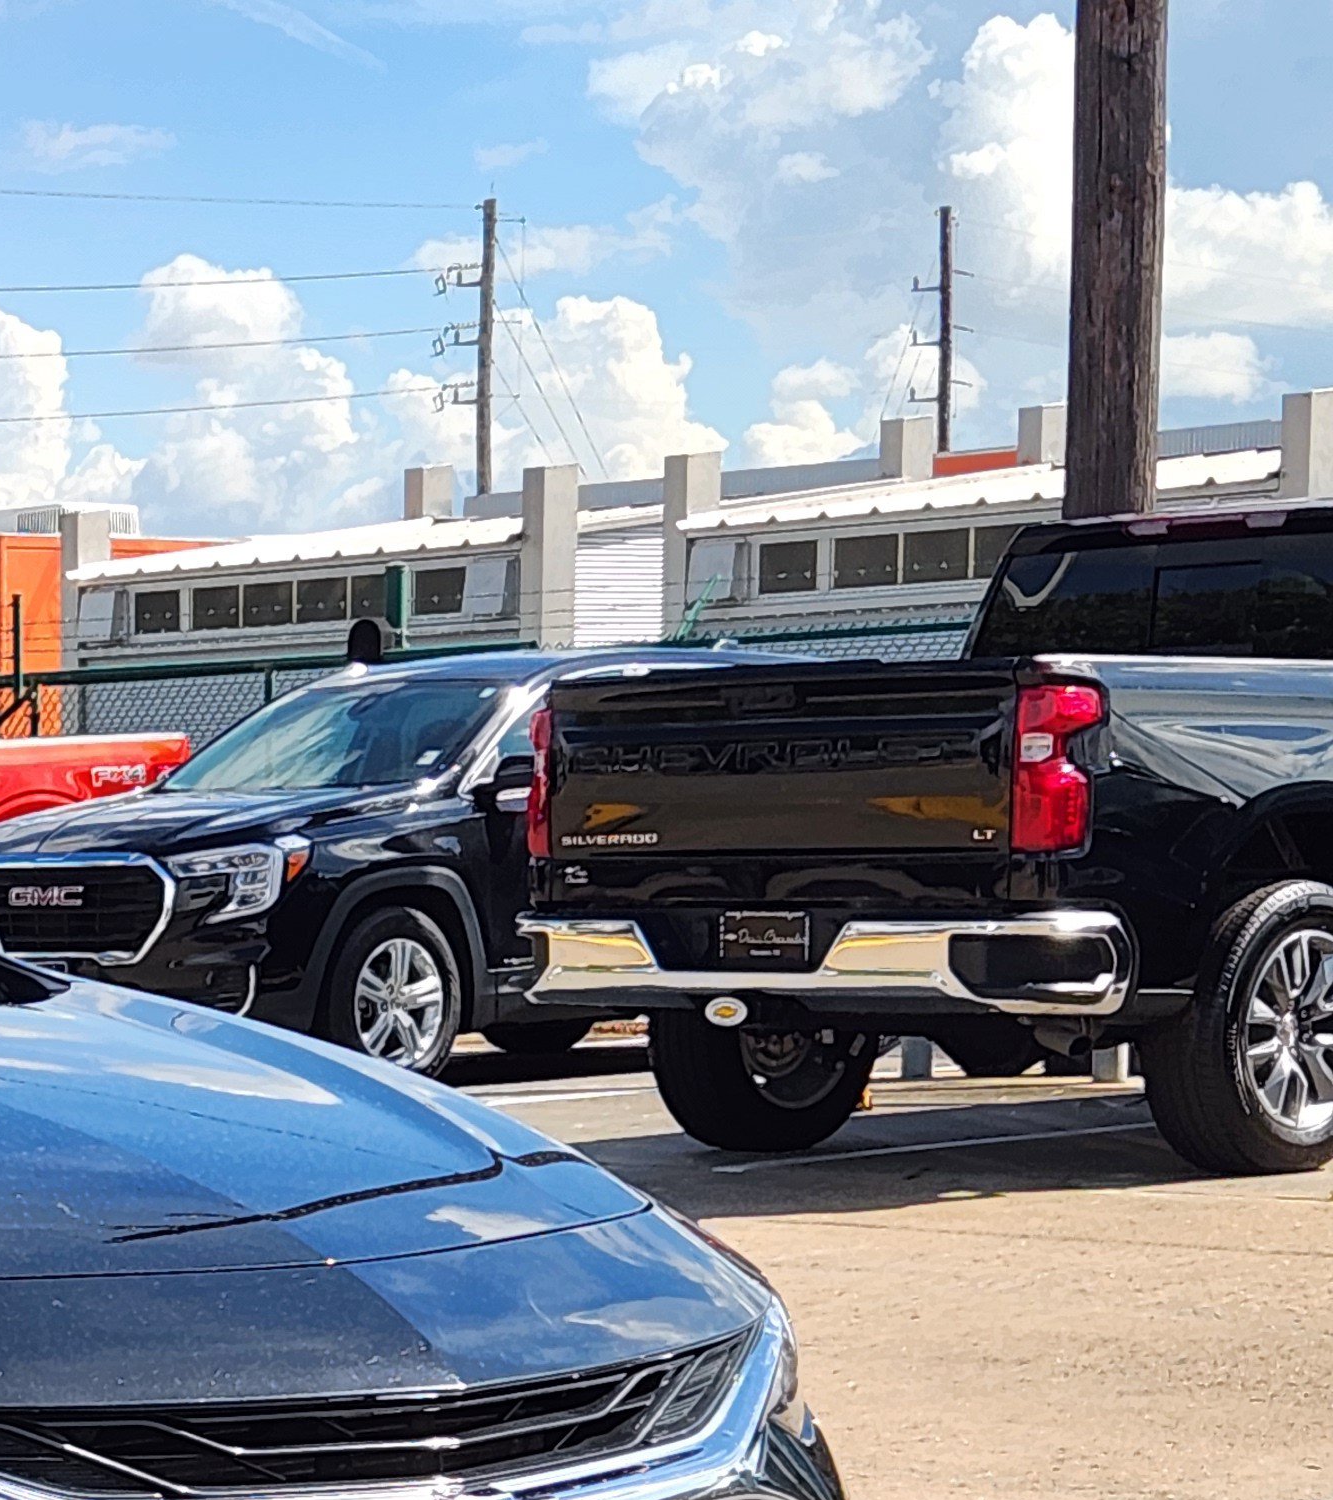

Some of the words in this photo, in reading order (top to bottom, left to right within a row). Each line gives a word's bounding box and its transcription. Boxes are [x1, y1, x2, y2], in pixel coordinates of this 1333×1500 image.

[91, 763, 146, 787] FX4
[561, 832, 658, 847] SILVERADO
[973, 828, 996, 841] LT
[8, 885, 84, 906] GMC
